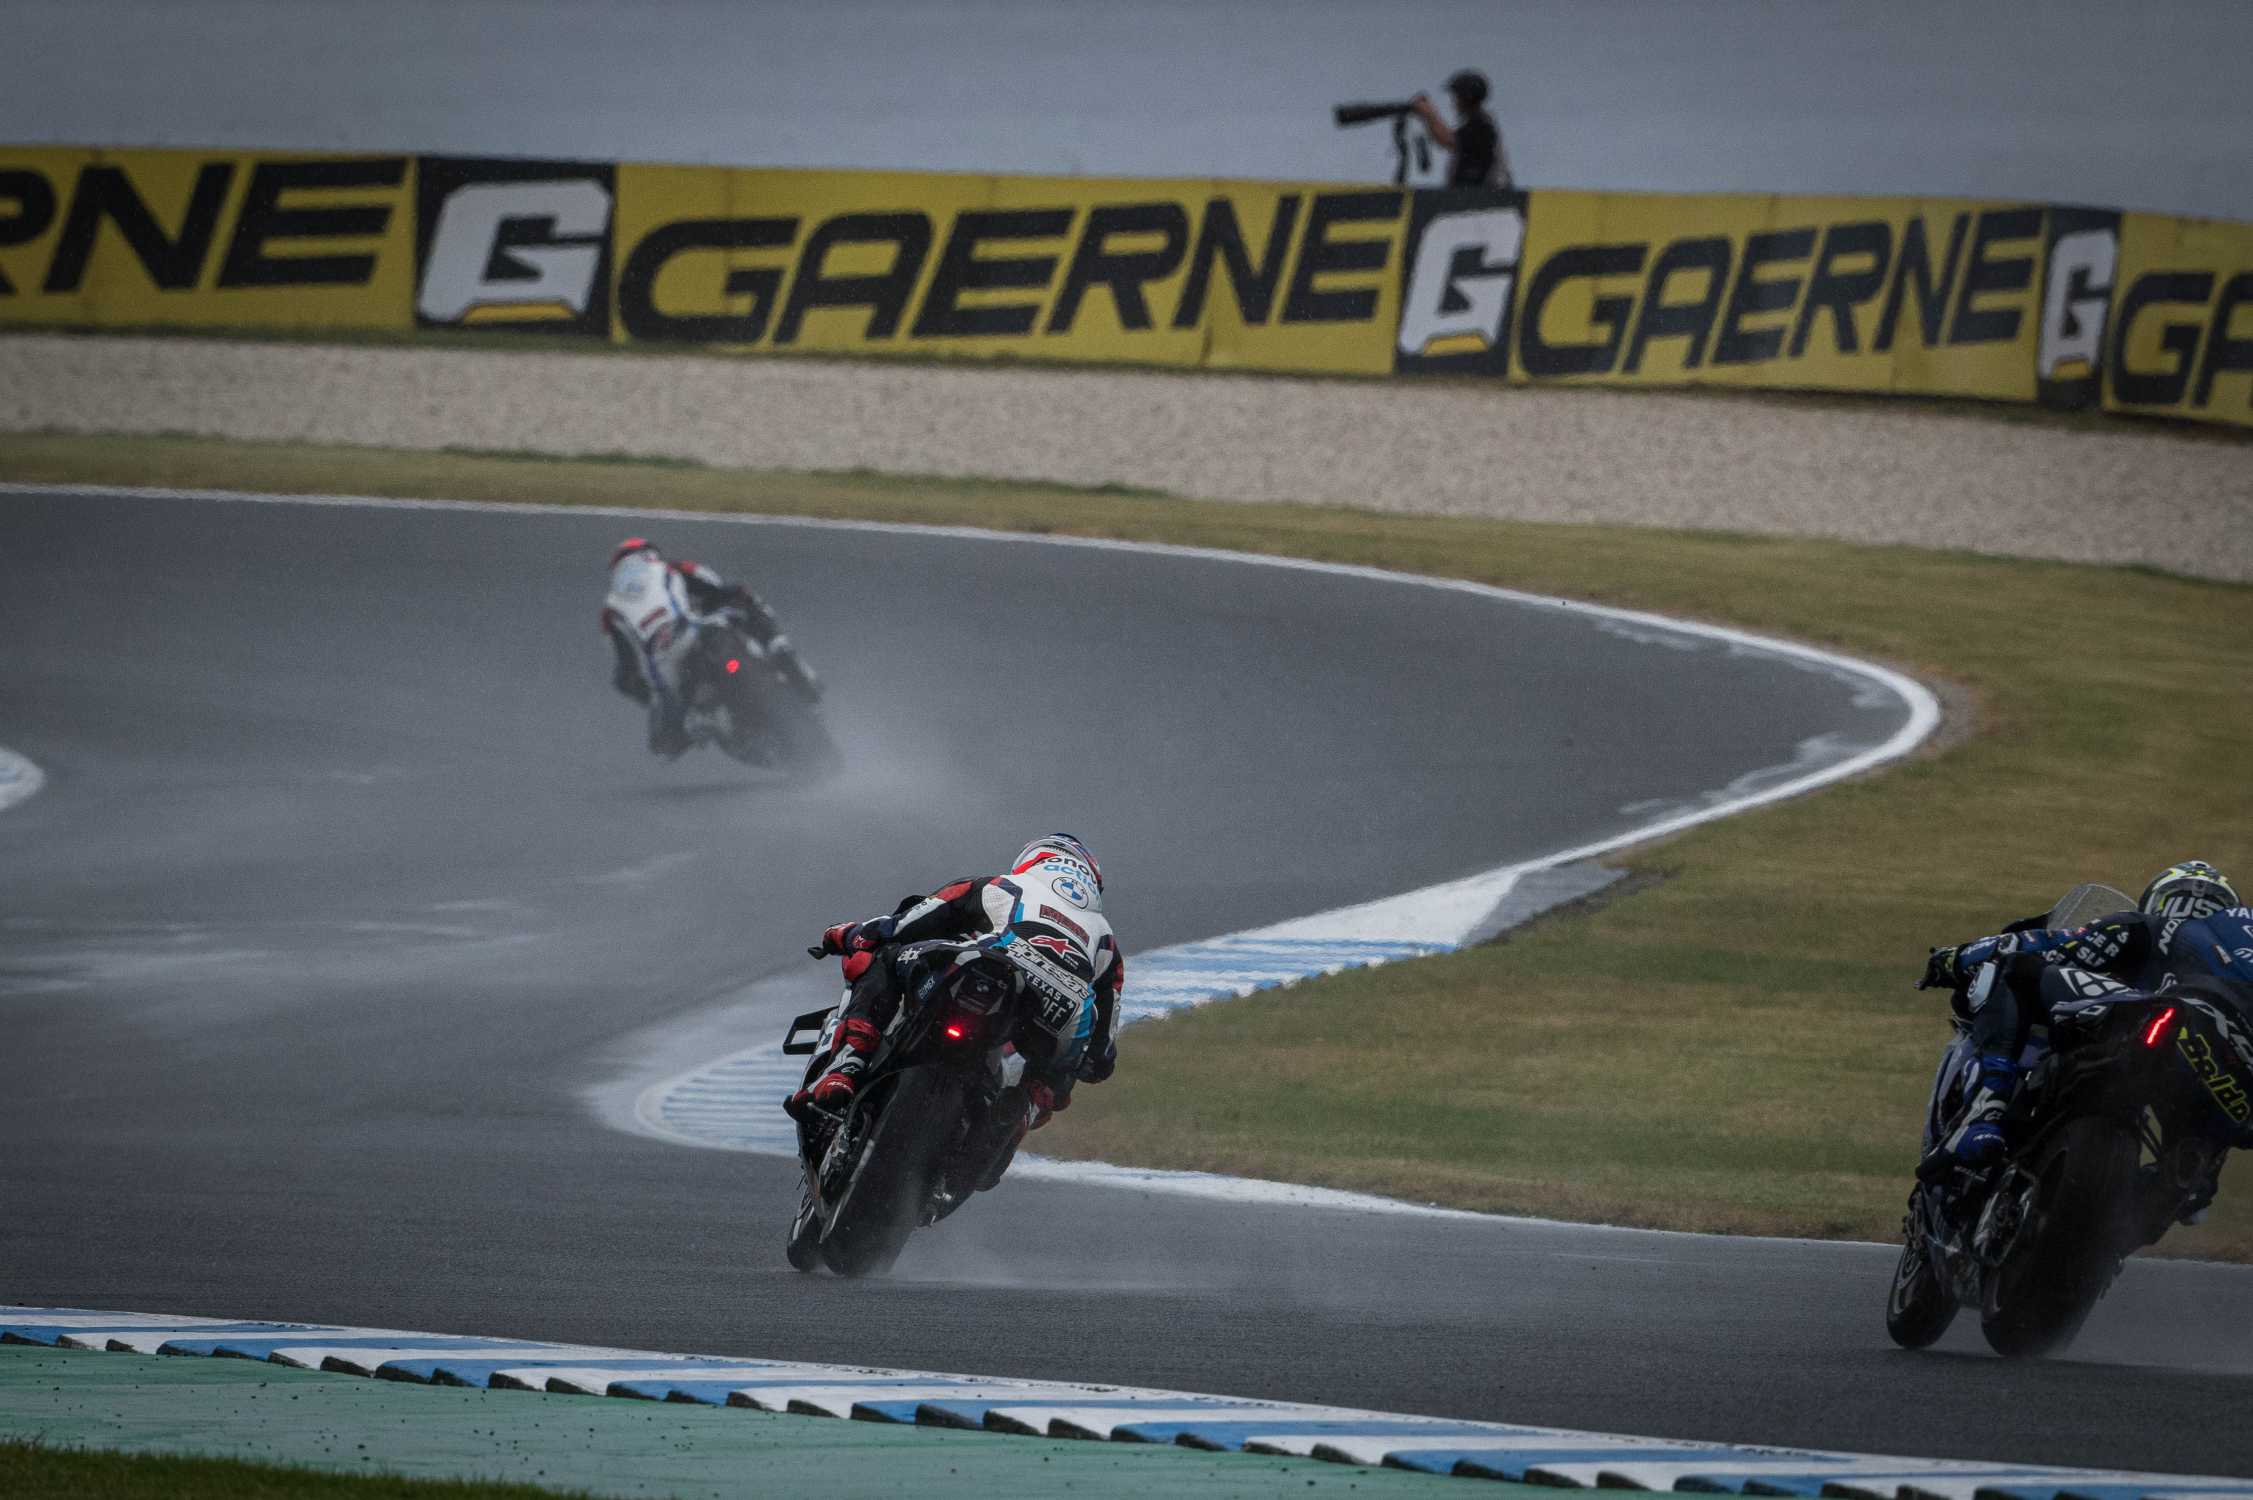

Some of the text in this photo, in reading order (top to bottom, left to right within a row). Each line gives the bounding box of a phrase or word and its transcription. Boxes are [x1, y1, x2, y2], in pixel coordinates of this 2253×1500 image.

[0, 159, 407, 296] NE
[616, 193, 1404, 346] GAERNE
[1518, 208, 2044, 378] GAERNE
[2225, 907, 2253, 920] YA
[1025, 971, 1062, 1002] TEXAS
